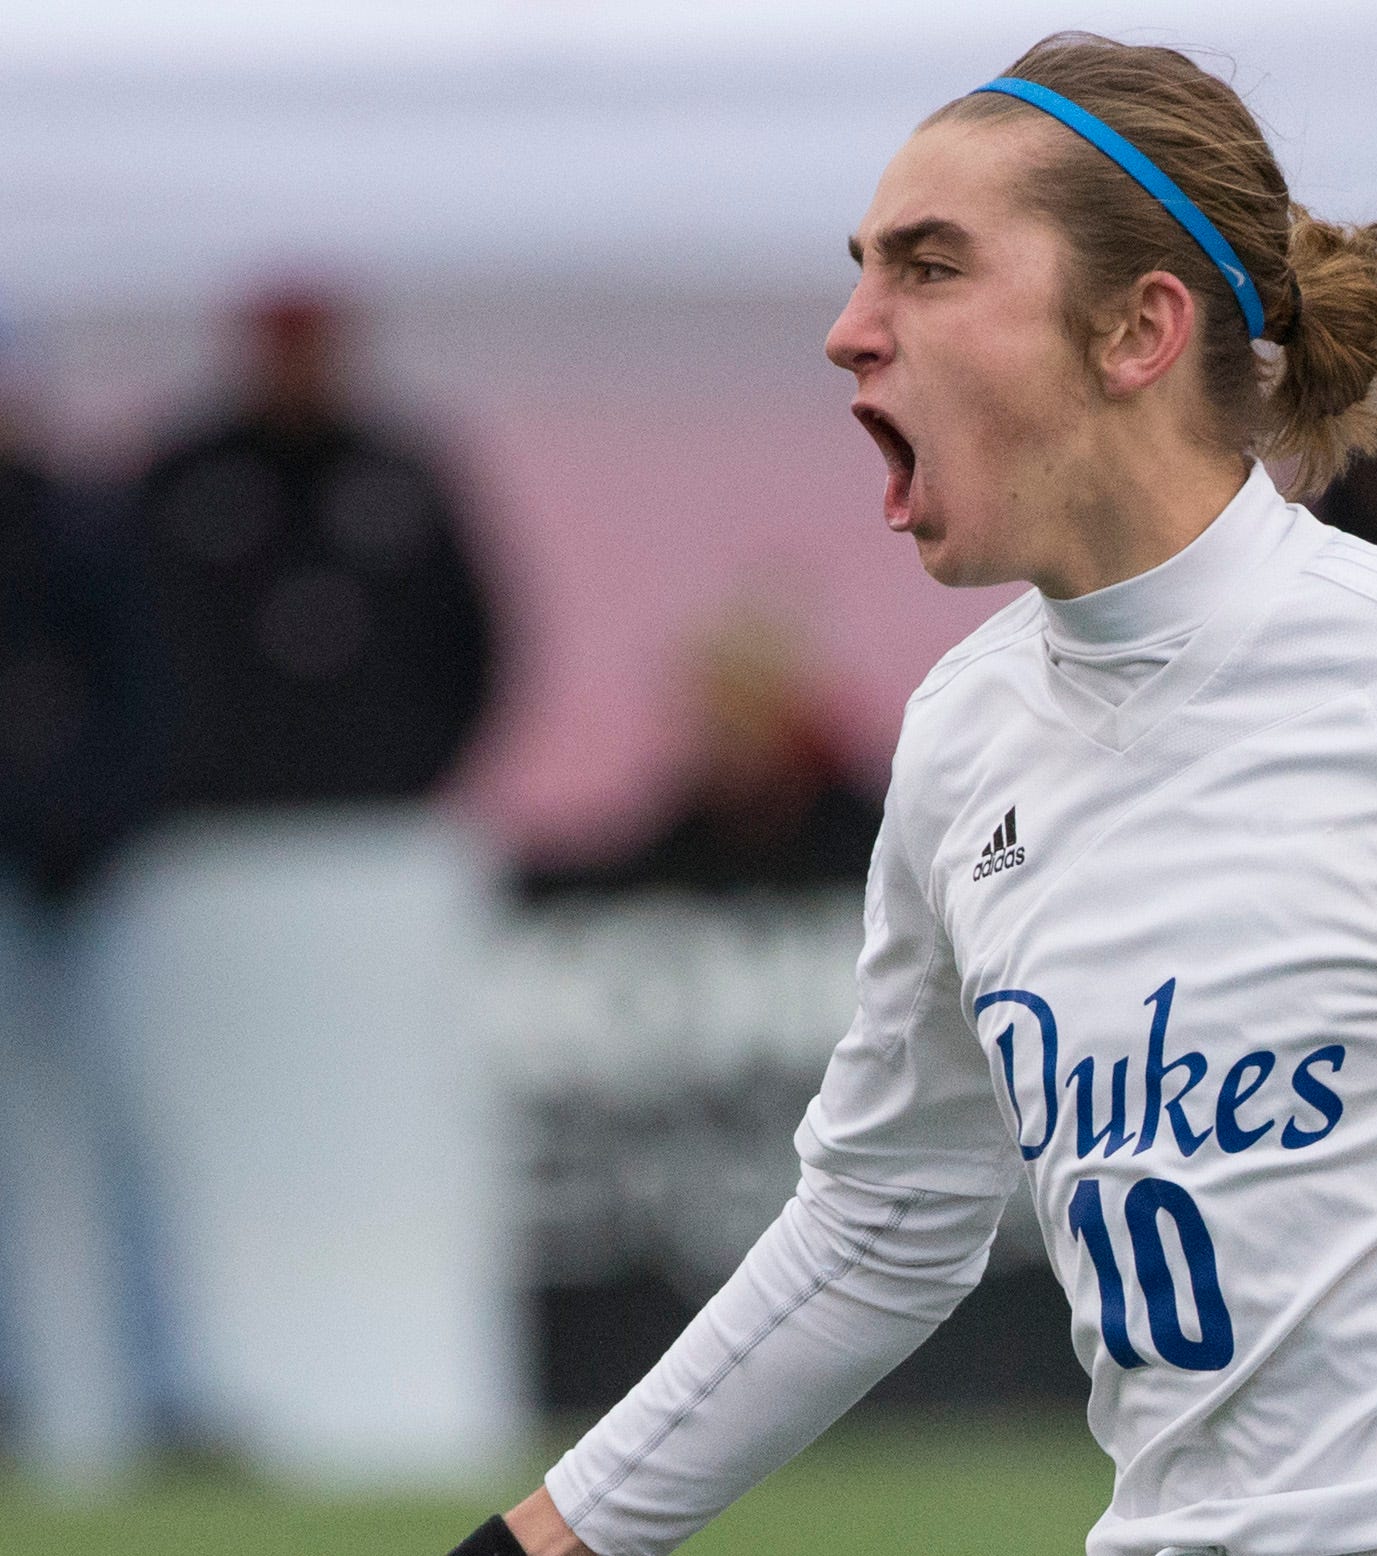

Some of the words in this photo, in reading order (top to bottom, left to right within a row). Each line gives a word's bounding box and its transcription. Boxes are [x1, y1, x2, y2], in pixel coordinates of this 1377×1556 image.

[973, 846, 1025, 882] adidas
[974, 977, 1346, 1161] Dukes
[1068, 1177, 1235, 1371] 10
